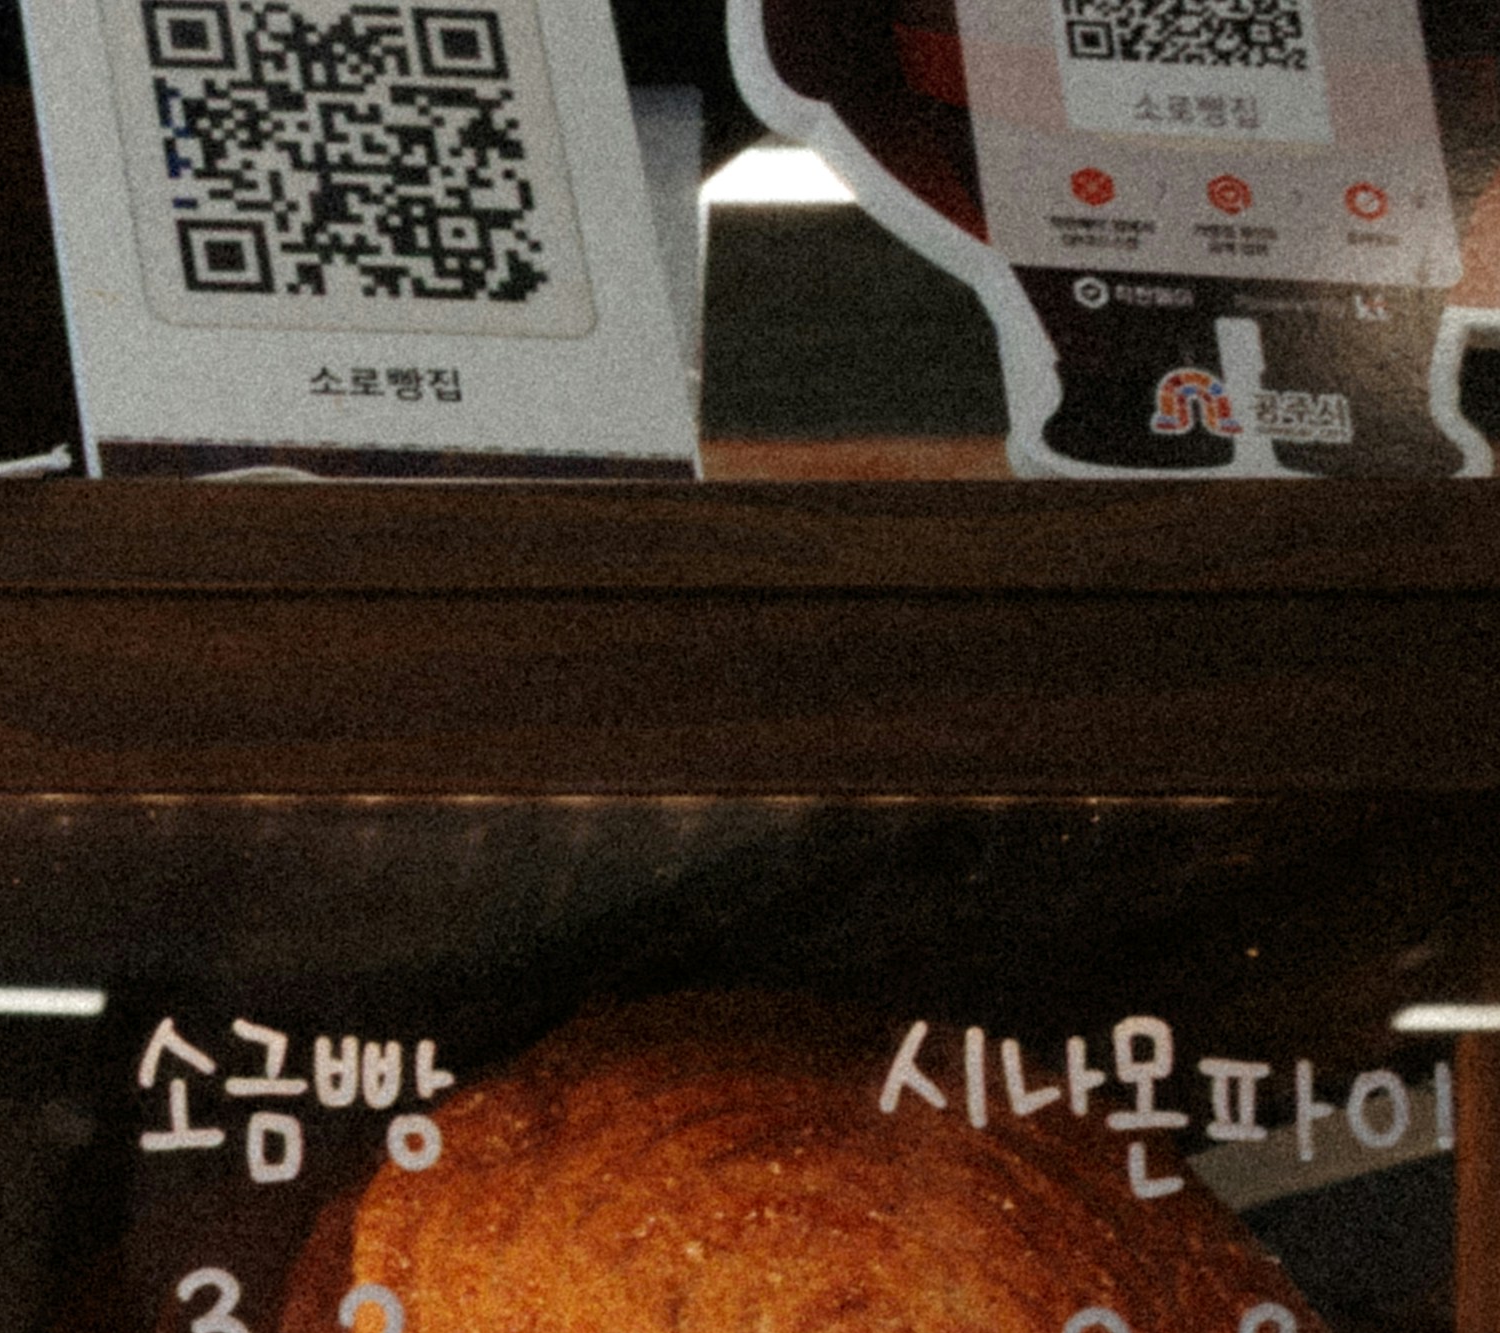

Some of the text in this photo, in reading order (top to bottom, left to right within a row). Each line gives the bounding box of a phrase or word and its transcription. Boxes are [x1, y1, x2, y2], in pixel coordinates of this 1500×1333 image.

[309, 366, 462, 402] 소로빵집
[137, 1017, 456, 1185] 소금빵
[878, 1014, 1455, 1200] 시나몬파이
